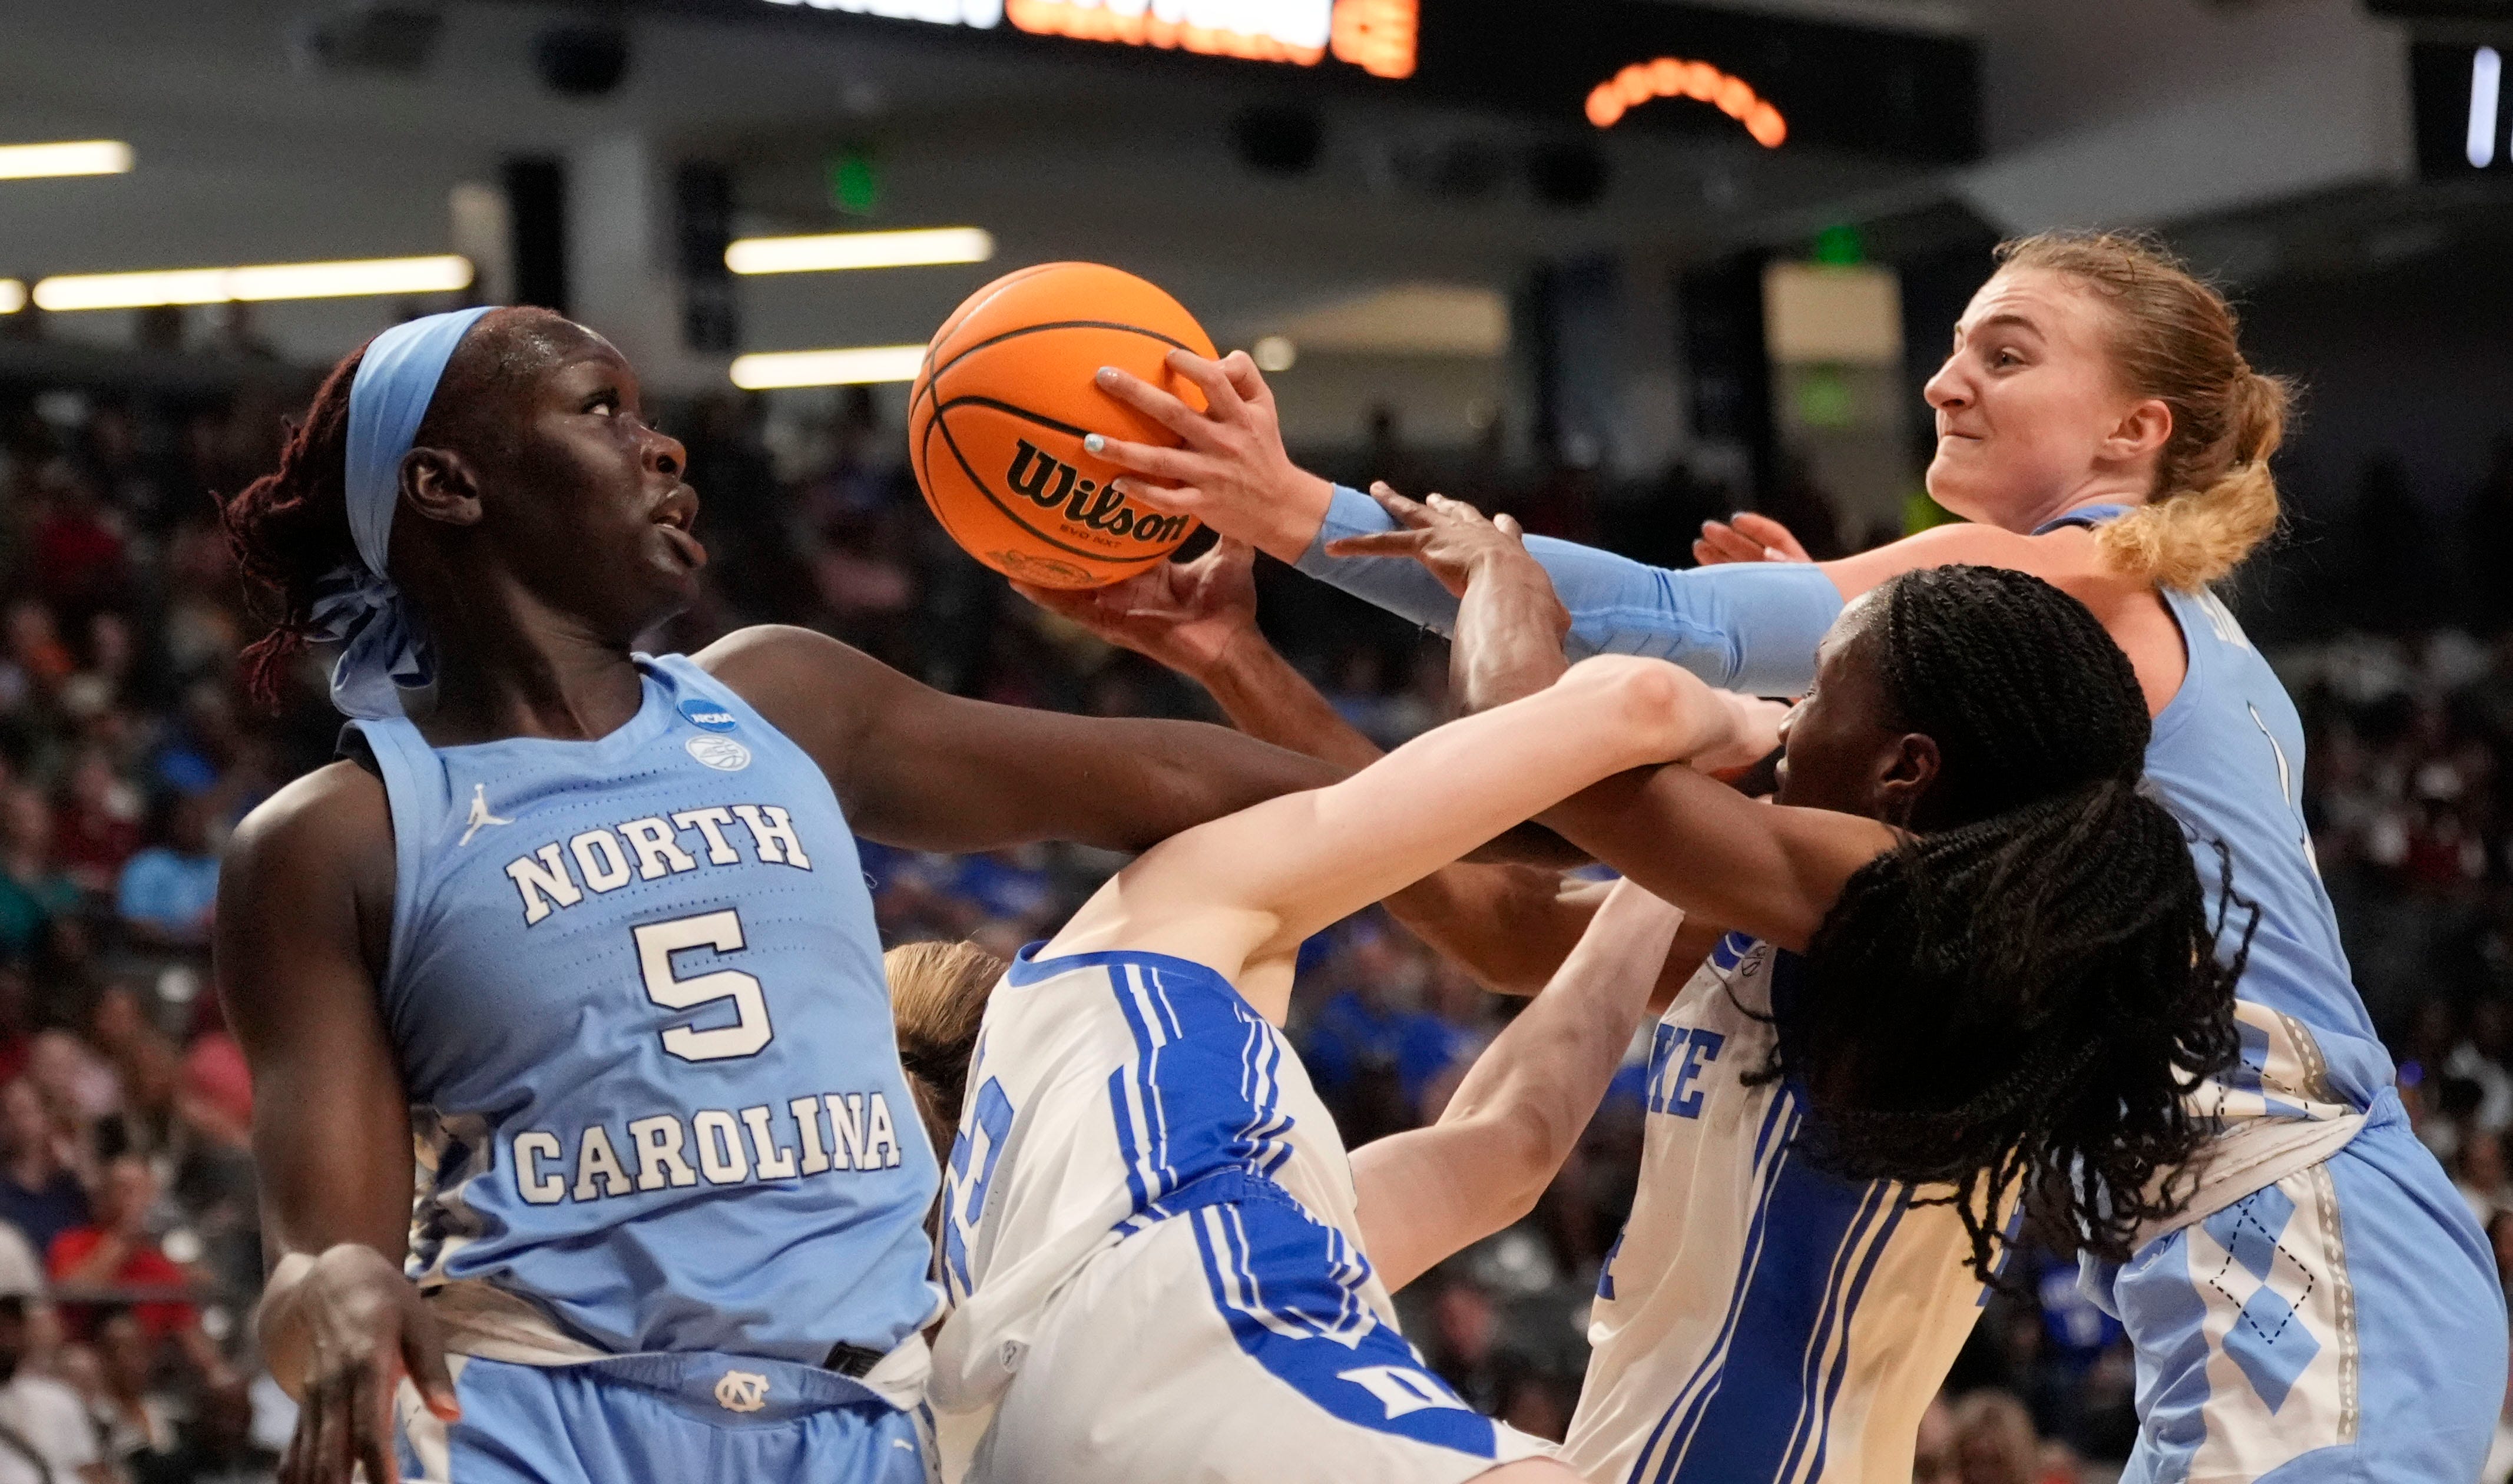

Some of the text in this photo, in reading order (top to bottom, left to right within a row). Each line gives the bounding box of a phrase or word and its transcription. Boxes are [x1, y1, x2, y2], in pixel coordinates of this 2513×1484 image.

[1006, 437, 1190, 544] Wilson
[690, 713, 736, 724] NCAA
[505, 804, 812, 928] NORTH
[630, 908, 775, 1064] 5
[1647, 1022, 1726, 1119] KE
[512, 1091, 902, 1207] CAROLINA
